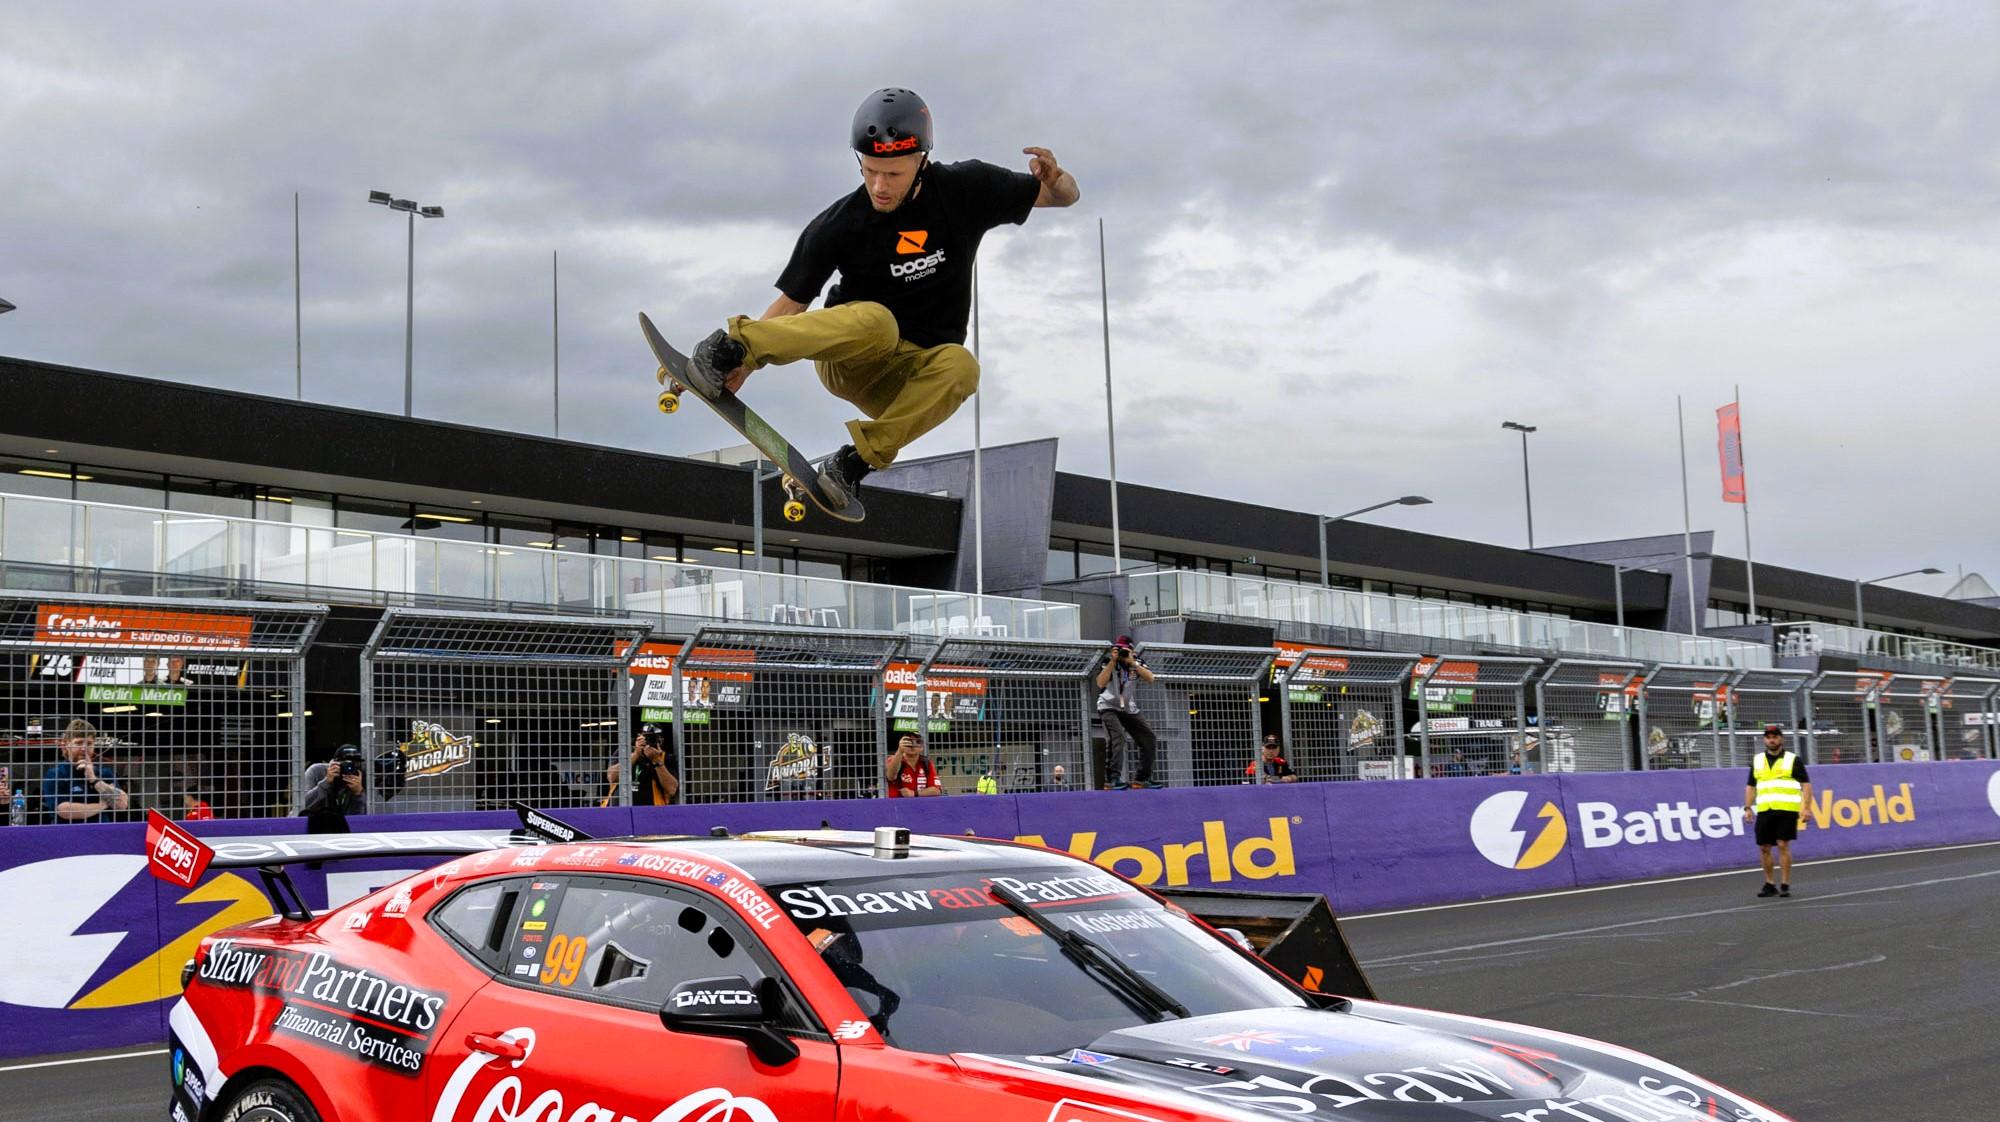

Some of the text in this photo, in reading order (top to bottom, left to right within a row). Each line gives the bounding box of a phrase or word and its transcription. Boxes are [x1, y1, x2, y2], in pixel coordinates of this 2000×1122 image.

[873, 135, 918, 153] boost
[890, 248, 946, 278] boost
[904, 266, 937, 283] mobile
[47, 613, 122, 639] Coates
[40, 654, 73, 677] 26
[885, 667, 918, 685] oates
[89, 686, 183, 702] Merlin Merlin
[526, 811, 575, 842] SUPERCHEAP
[1578, 801, 1758, 849] Batter
[158, 836, 193, 868] grays
[635, 854, 782, 931] KOSTECKI RUSSELL
[540, 933, 589, 987] 99
[672, 990, 757, 1008] DAYCO
[274, 1005, 422, 1071] Financial Services
[1165, 1057, 1236, 1075] ZL1
